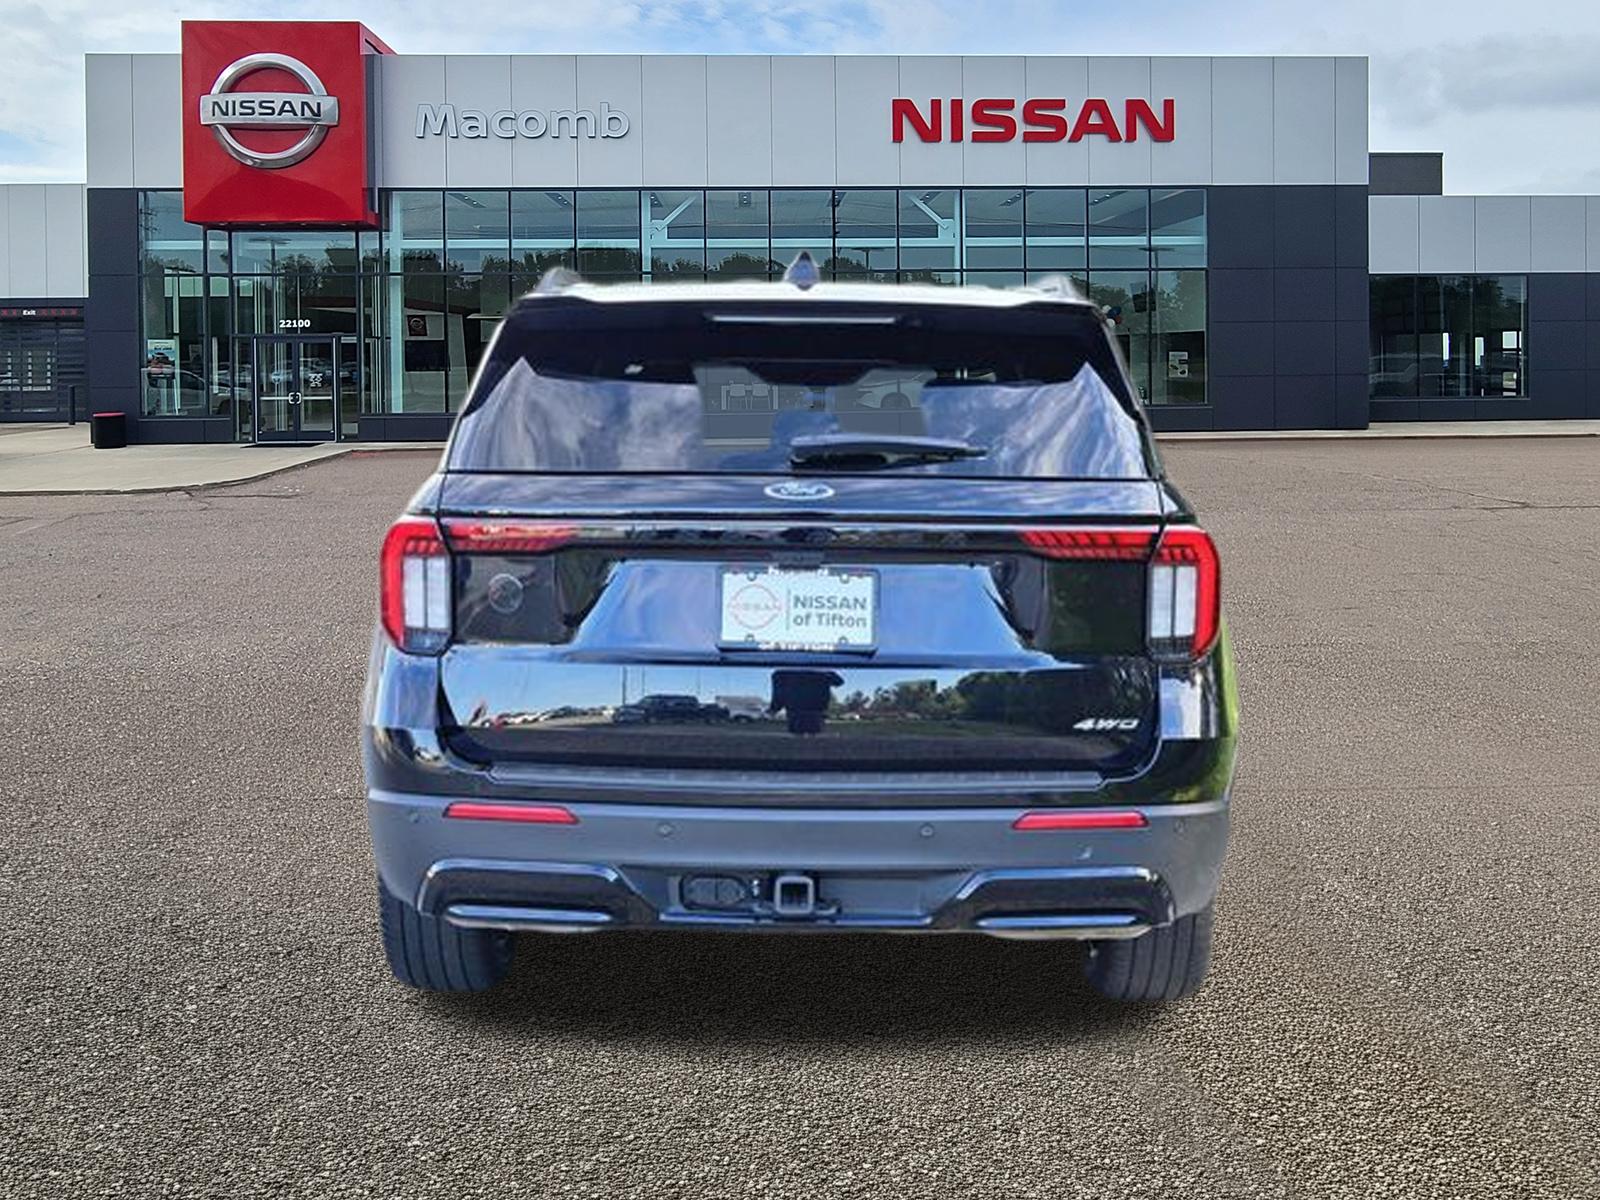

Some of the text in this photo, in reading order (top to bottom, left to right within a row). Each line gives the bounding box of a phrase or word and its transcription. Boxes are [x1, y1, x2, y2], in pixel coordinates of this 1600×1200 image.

[212, 101, 322, 118] NISSAN
[415, 102, 631, 139] Macomb
[891, 98, 1176, 143] NISSAN
[279, 319, 311, 328] 22100
[793, 595, 867, 610] NISSAN
[793, 613, 867, 628] of Tifton
